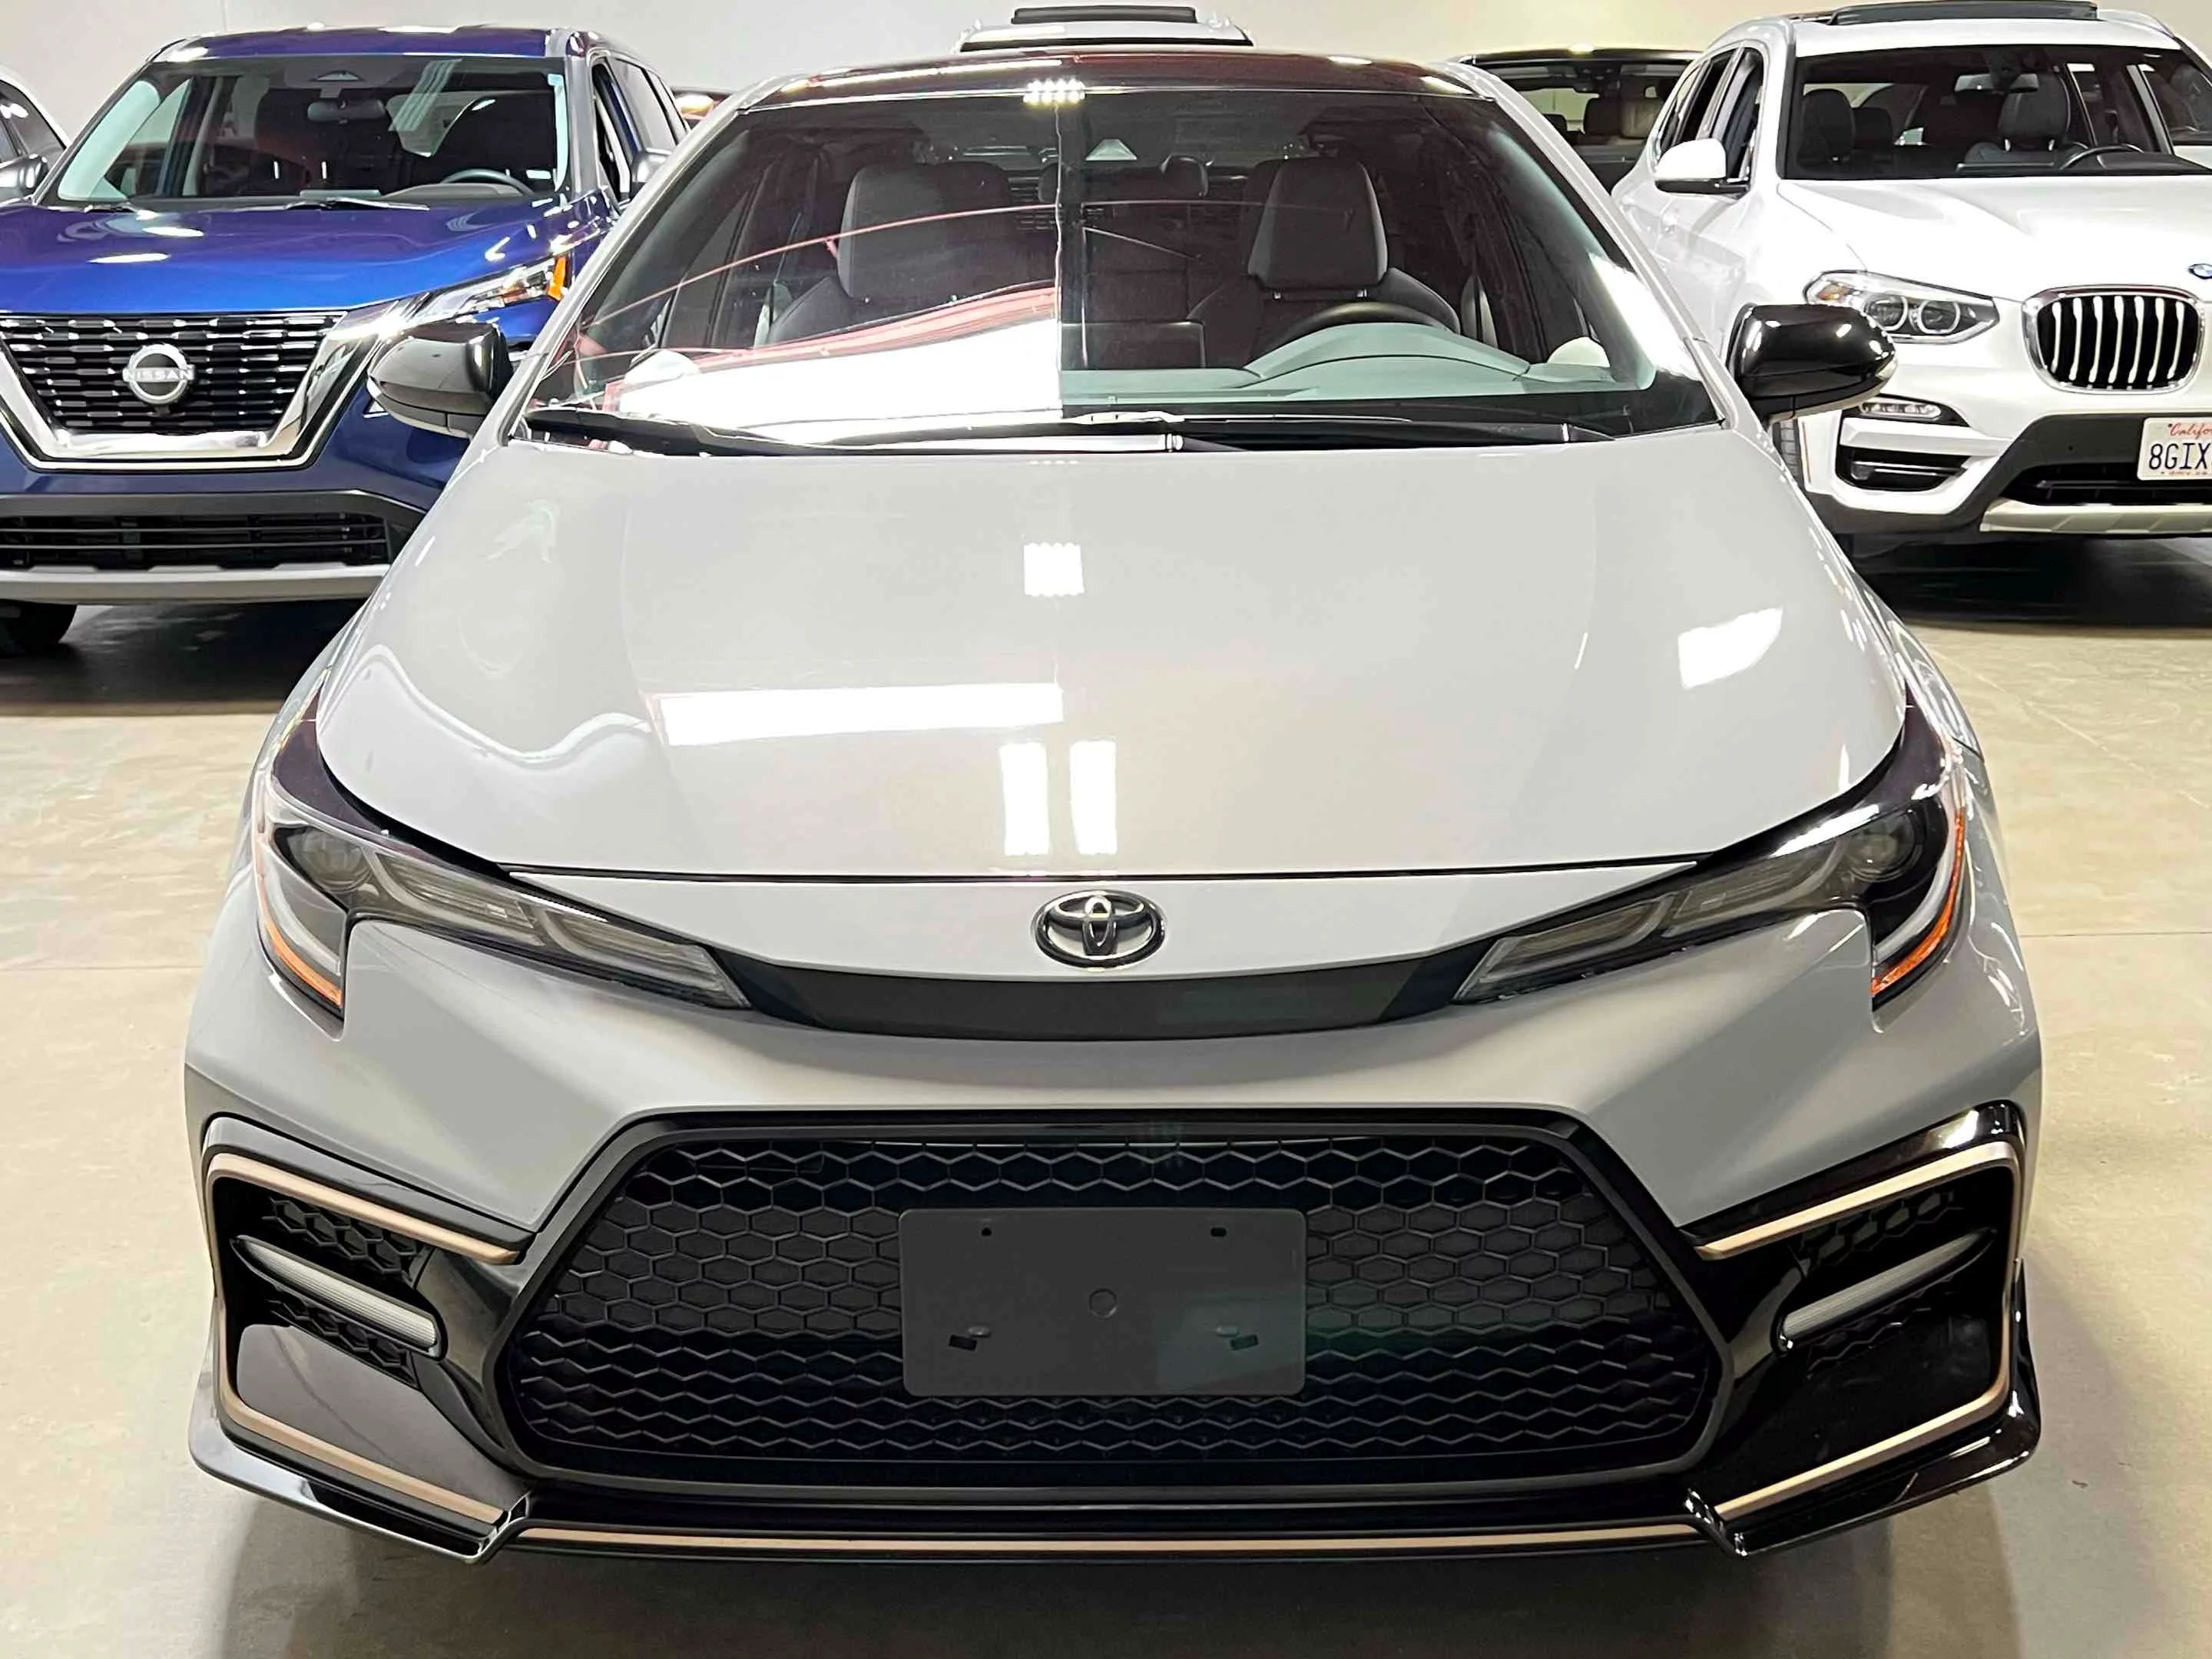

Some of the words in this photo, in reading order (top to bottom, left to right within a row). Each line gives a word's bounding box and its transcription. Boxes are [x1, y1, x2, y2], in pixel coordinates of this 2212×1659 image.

[123, 368, 194, 382] NISSAN
[2170, 422, 2212, 439] Califo
[2148, 442, 2212, 470] 8GIX
